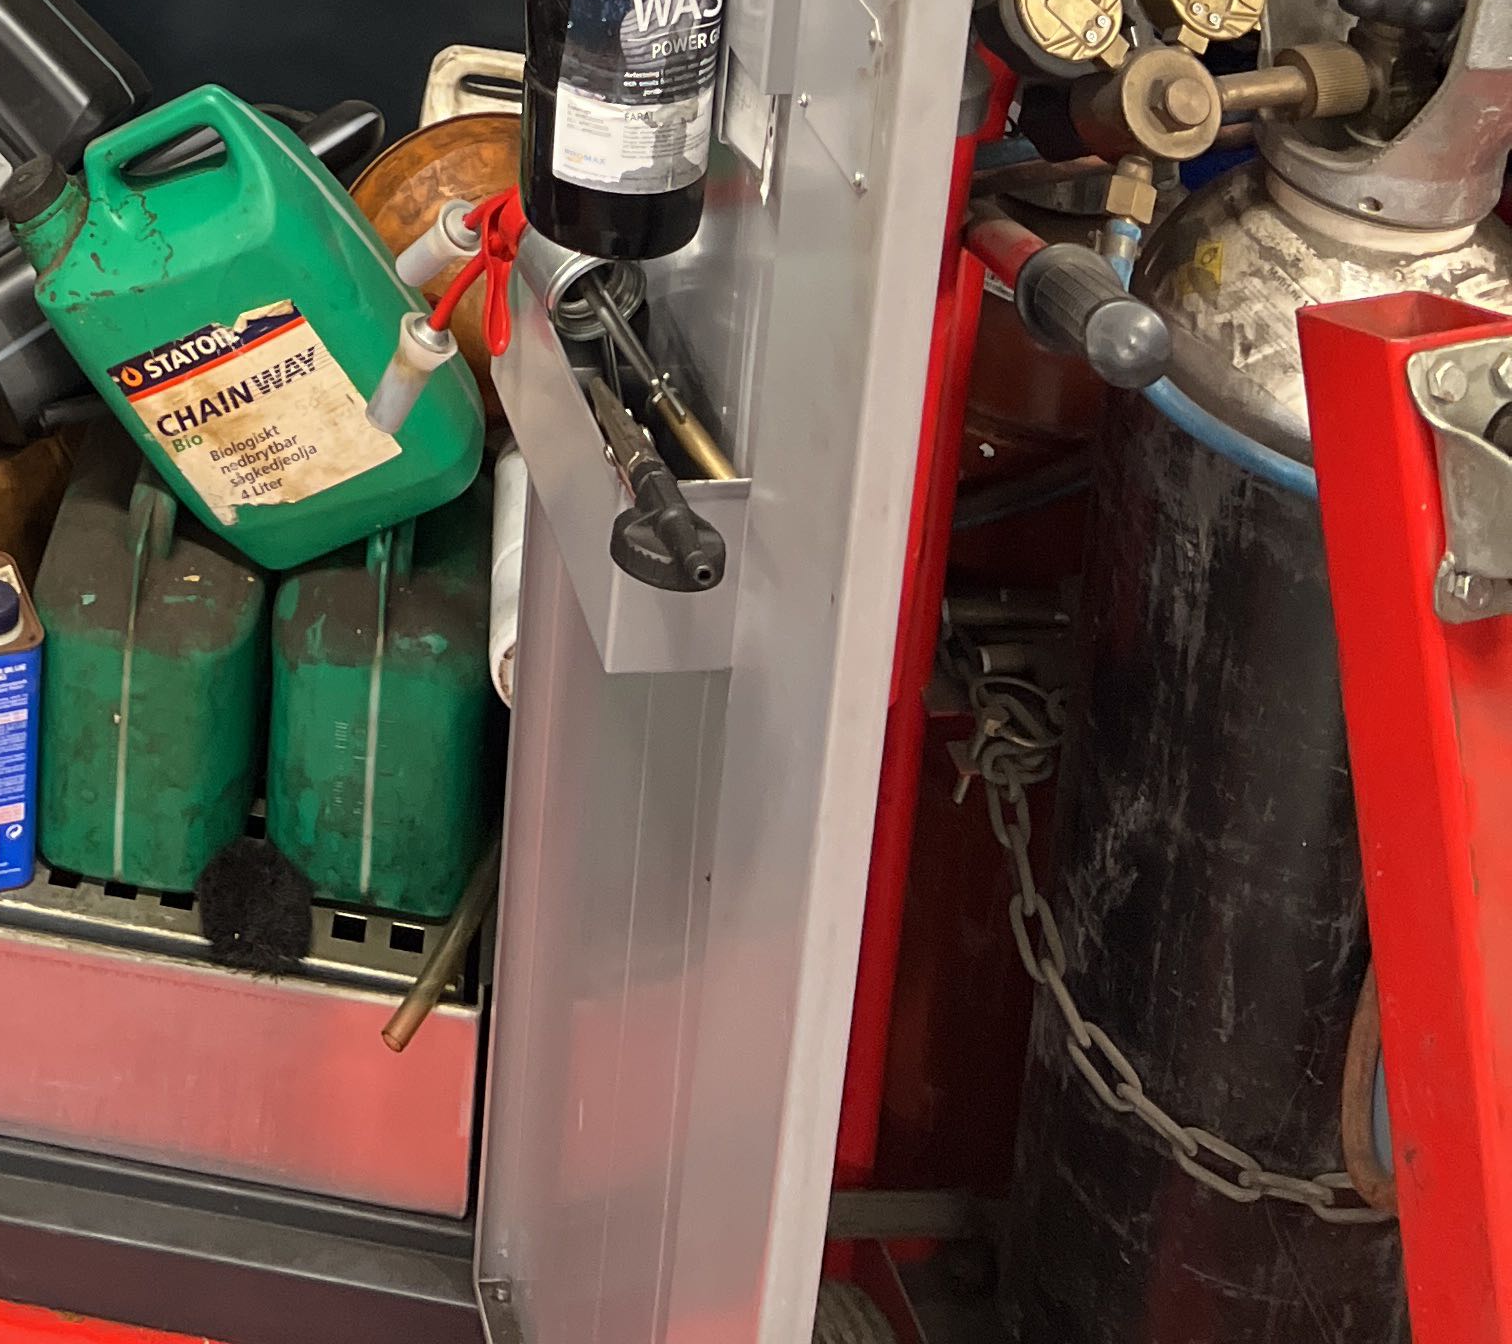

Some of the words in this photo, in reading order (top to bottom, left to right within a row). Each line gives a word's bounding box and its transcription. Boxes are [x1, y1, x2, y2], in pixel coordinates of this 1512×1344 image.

[651, 32, 707, 60] POWER
[171, 434, 204, 454] Bio
[209, 423, 281, 463] Biologiskt
[220, 432, 299, 475] nedbrytbar
[230, 443, 318, 489] sågkedjeolja
[240, 488, 251, 501] 4
[252, 476, 284, 498] Liter
